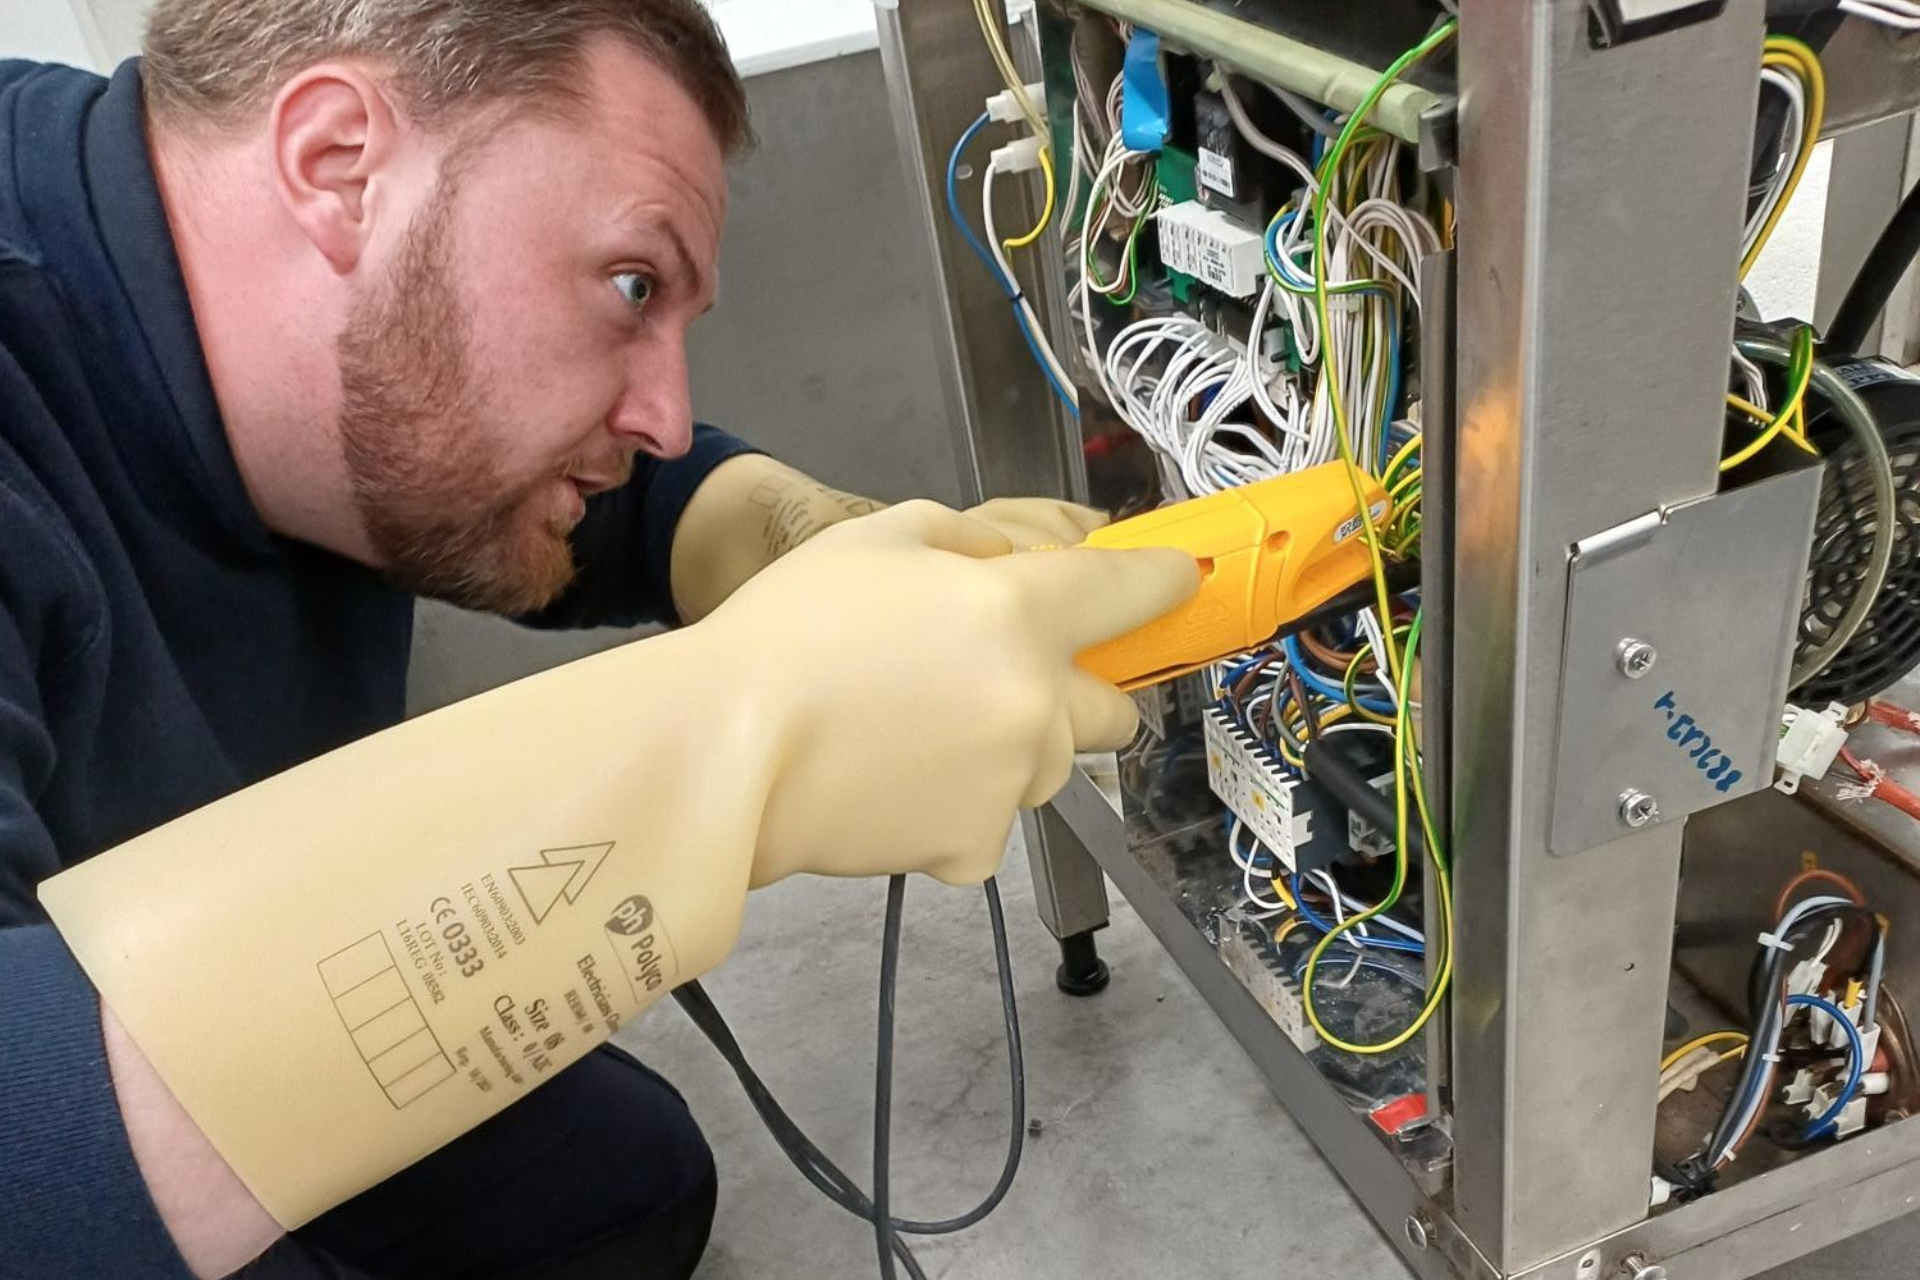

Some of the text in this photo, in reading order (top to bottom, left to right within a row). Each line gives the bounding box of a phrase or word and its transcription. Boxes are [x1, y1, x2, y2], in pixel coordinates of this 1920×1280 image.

[442, 922, 485, 978] 0333
[630, 933, 663, 992] Polyco
[523, 998, 550, 1033] Size
